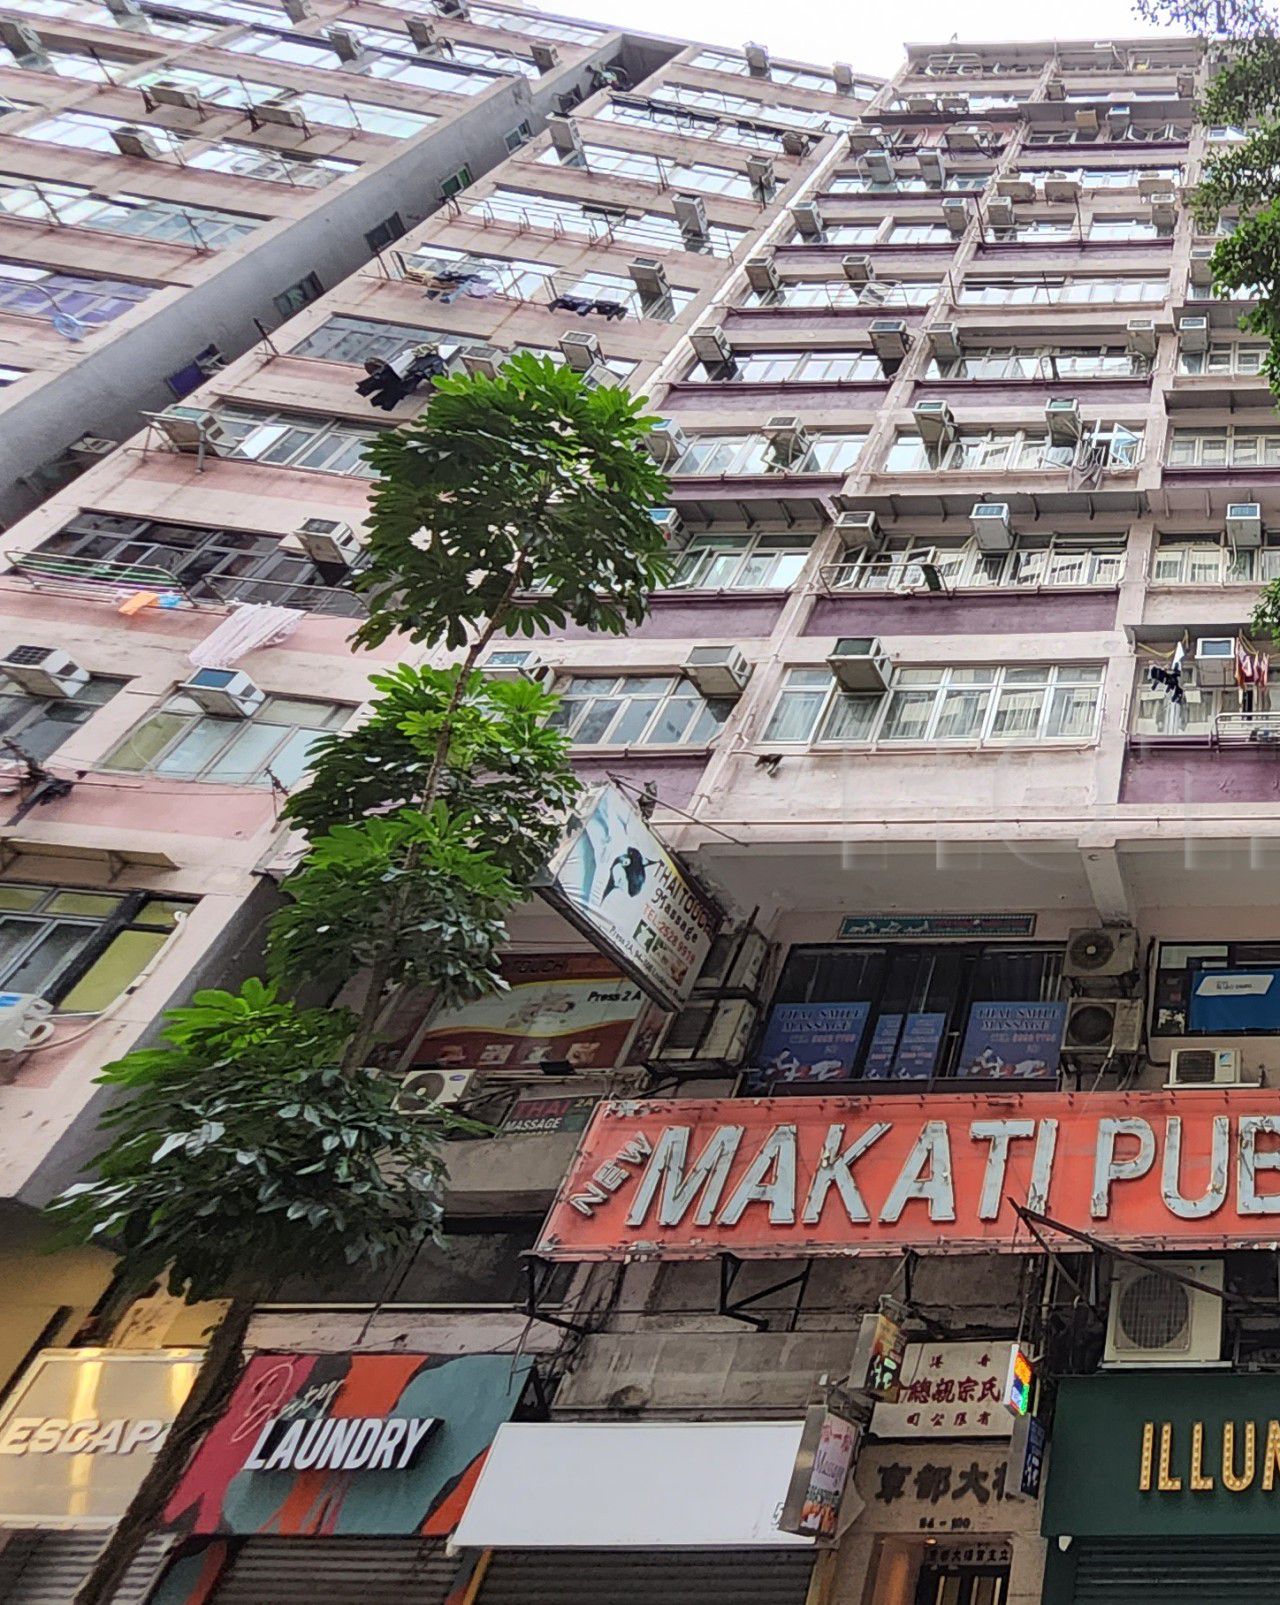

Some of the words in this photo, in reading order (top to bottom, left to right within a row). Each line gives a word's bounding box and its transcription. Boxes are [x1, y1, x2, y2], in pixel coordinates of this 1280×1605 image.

[653, 859, 681, 900] THAI
[650, 887, 700, 943] Massage
[587, 989, 620, 1002] Press
[574, 1098, 594, 1107] 2A
[504, 1117, 563, 1131] MASSAGE
[568, 1130, 655, 1217] NEW
[624, 1119, 1059, 1227] MAKATI
[243, 1416, 438, 1471] LAUNDRY
